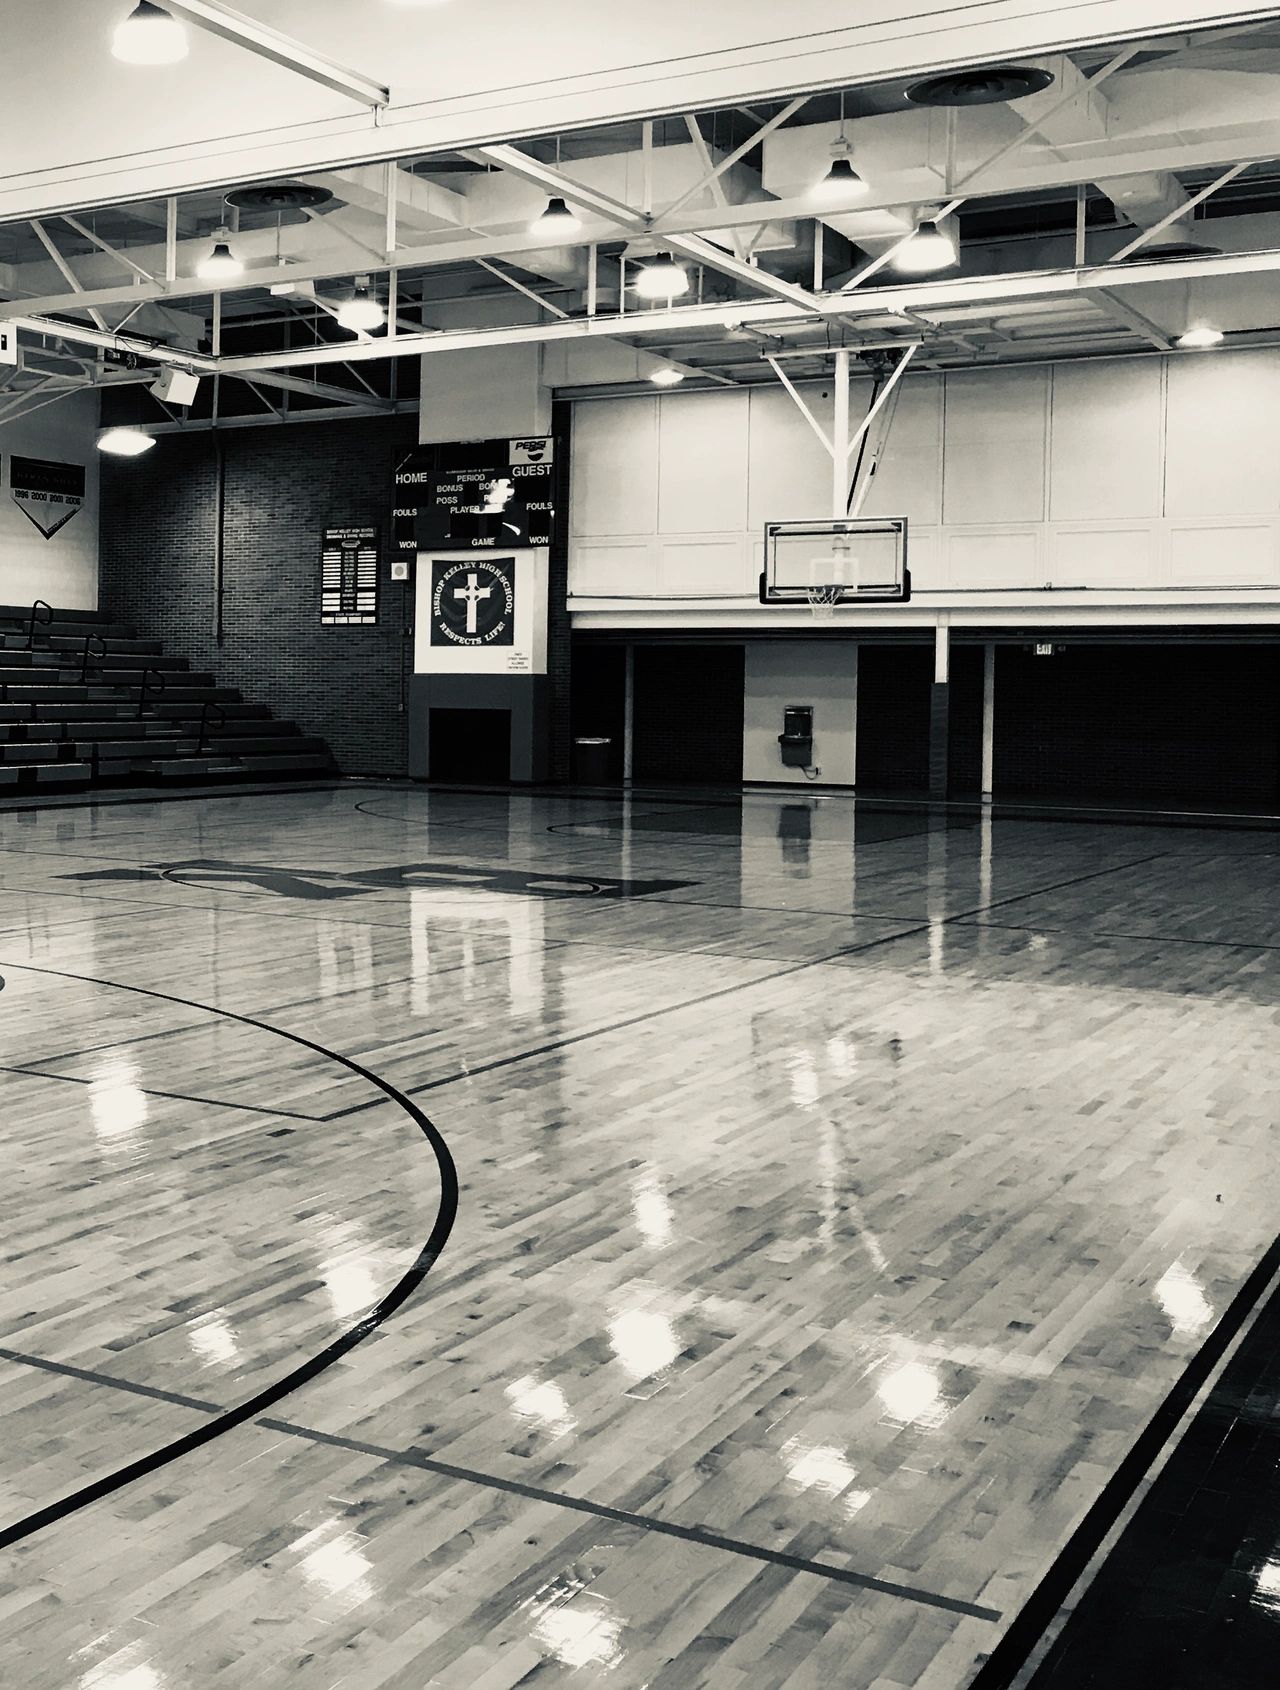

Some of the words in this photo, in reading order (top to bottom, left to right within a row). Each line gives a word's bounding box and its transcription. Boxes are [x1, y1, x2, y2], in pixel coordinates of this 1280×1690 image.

[512, 464, 553, 477] GUEST
[395, 472, 428, 484] HOME
[456, 473, 486, 483] PERIOD
[436, 484, 464, 493] BONUS
[436, 496, 458, 504] POSS
[450, 505, 480, 514] PLAYER
[526, 502, 553, 510] FOULS
[392, 508, 418, 517] FOULS
[398, 540, 418, 549] WON
[471, 536, 495, 546] GAME
[529, 536, 549, 544] WON
[433, 579, 446, 616] BISHOP
[443, 562, 477, 580] KELLEY
[478, 562, 502, 578] HIGH
[498, 575, 513, 615] SCHOOL
[439, 622, 482, 645] RESPECTS
